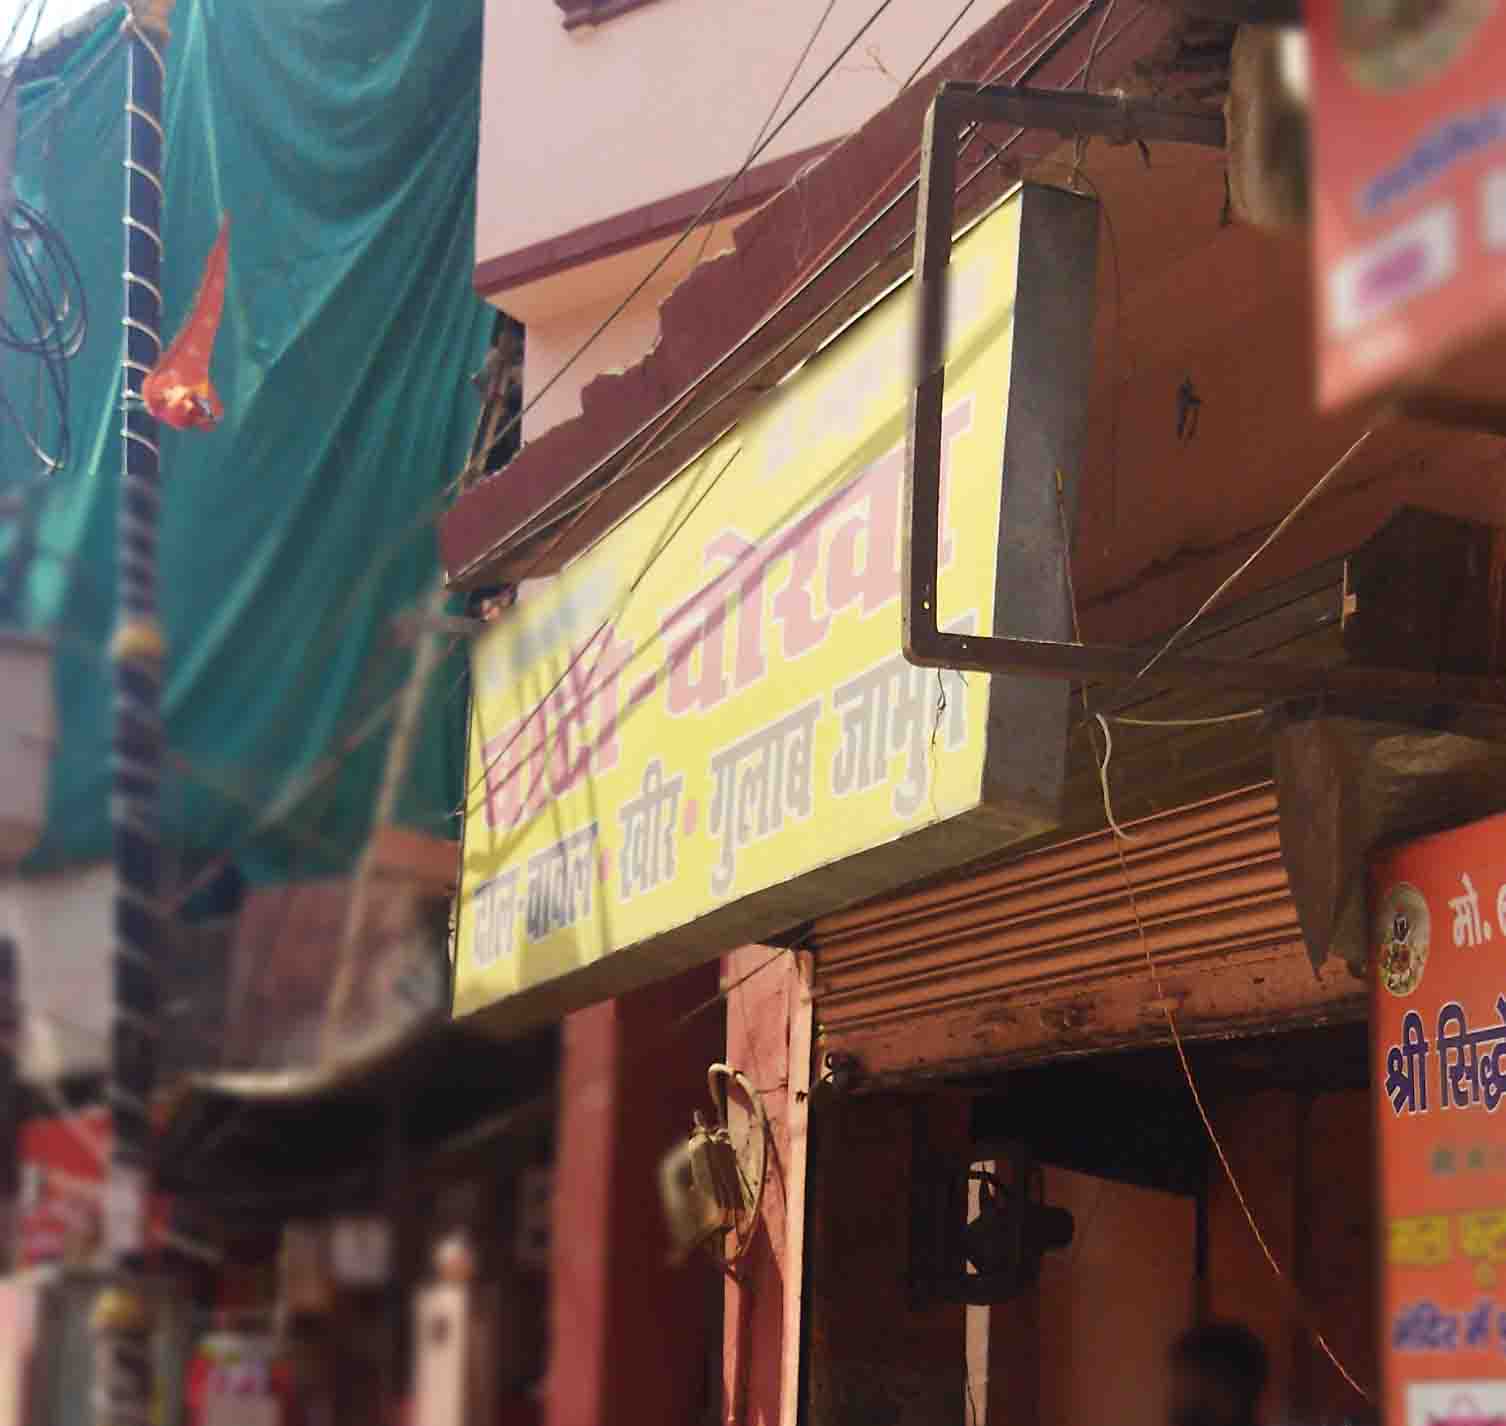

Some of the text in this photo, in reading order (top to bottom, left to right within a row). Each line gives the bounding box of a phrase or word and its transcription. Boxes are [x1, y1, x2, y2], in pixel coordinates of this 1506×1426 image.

[617, 758, 684, 902] खीर
[708, 696, 822, 894] गुलाब
[1384, 1009, 1430, 1118] श्री
